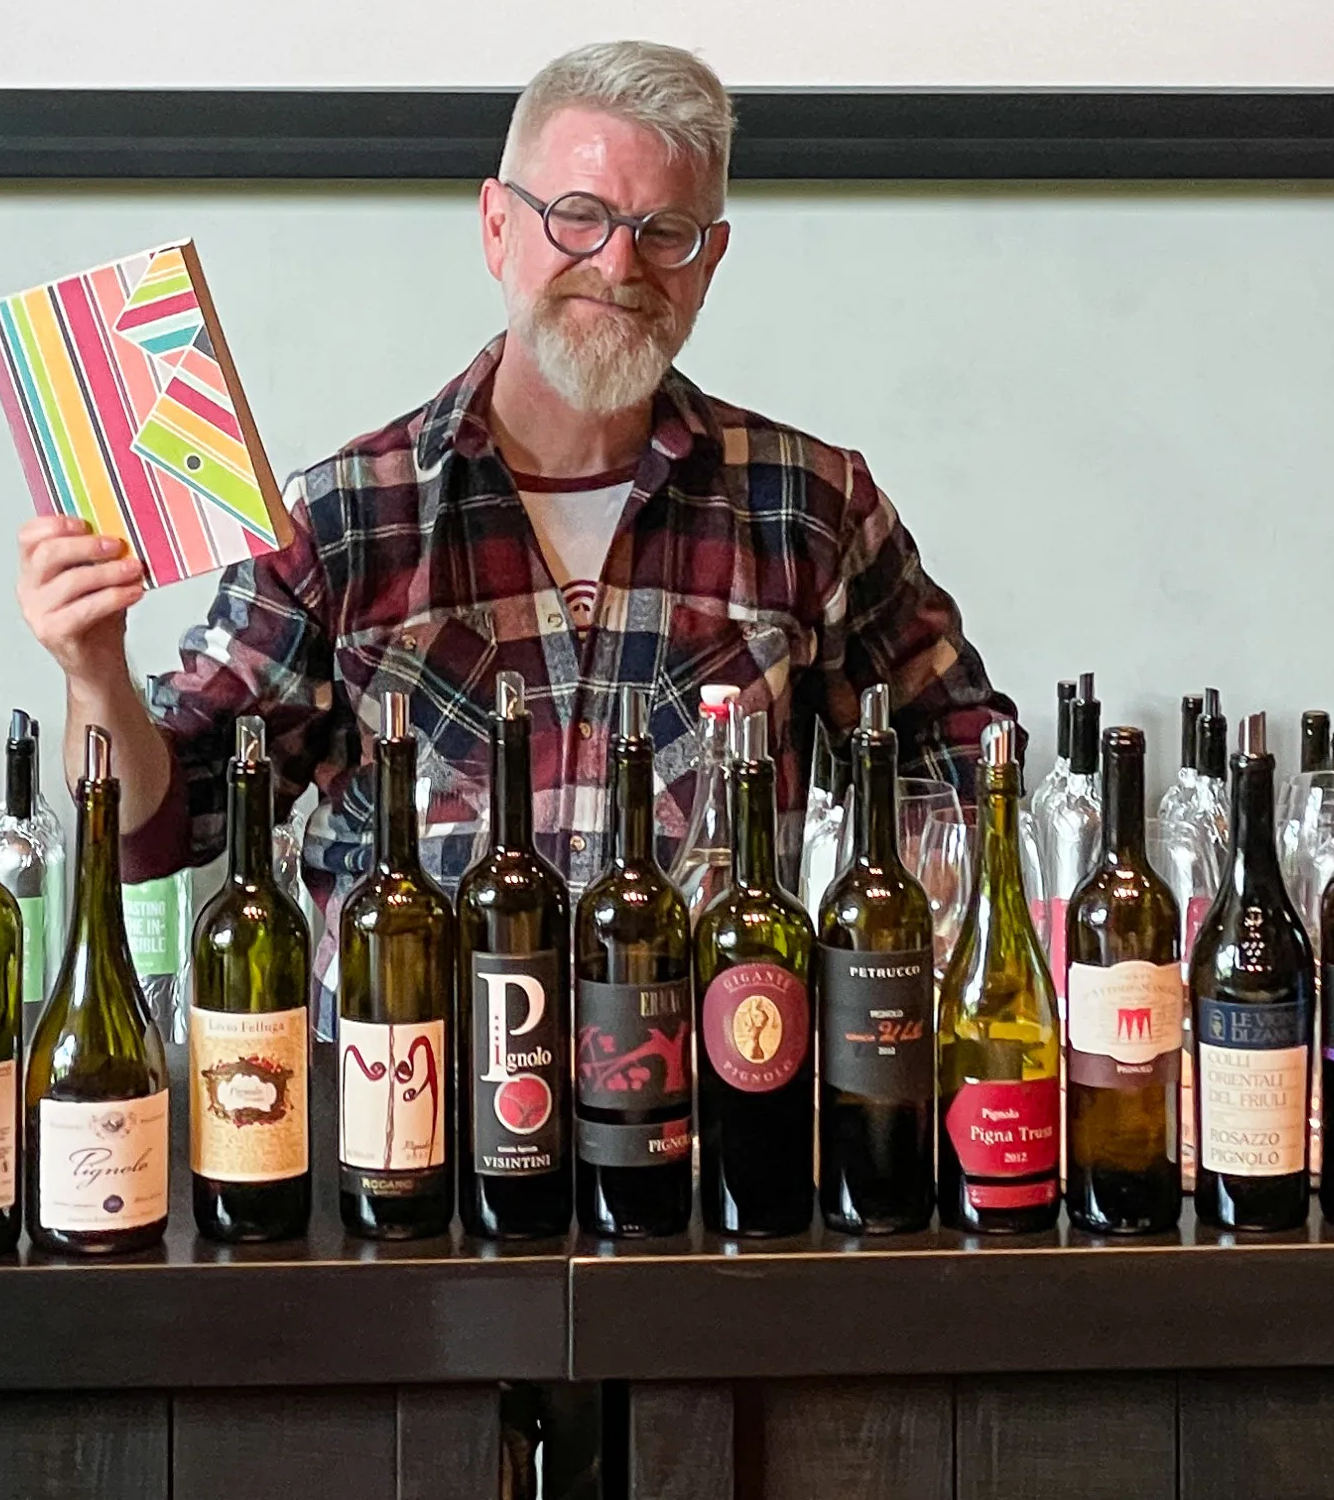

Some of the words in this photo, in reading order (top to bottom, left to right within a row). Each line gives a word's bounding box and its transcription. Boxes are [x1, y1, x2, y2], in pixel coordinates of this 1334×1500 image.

[849, 965, 921, 978] PETRUCCO
[1231, 1011, 1252, 1027] LE
[1207, 1051, 1250, 1068] COLLI
[1208, 1070, 1284, 1088] ORIENTALI
[1240, 1091, 1287, 1108] FRIULI
[970, 1125, 1014, 1146] Pigna
[1210, 1127, 1281, 1147] ROSAZZO
[482, 1154, 551, 1169] VISINTINI
[1210, 1147, 1281, 1167] PIGNOLO
[68, 1146, 153, 1191] Pignolo
